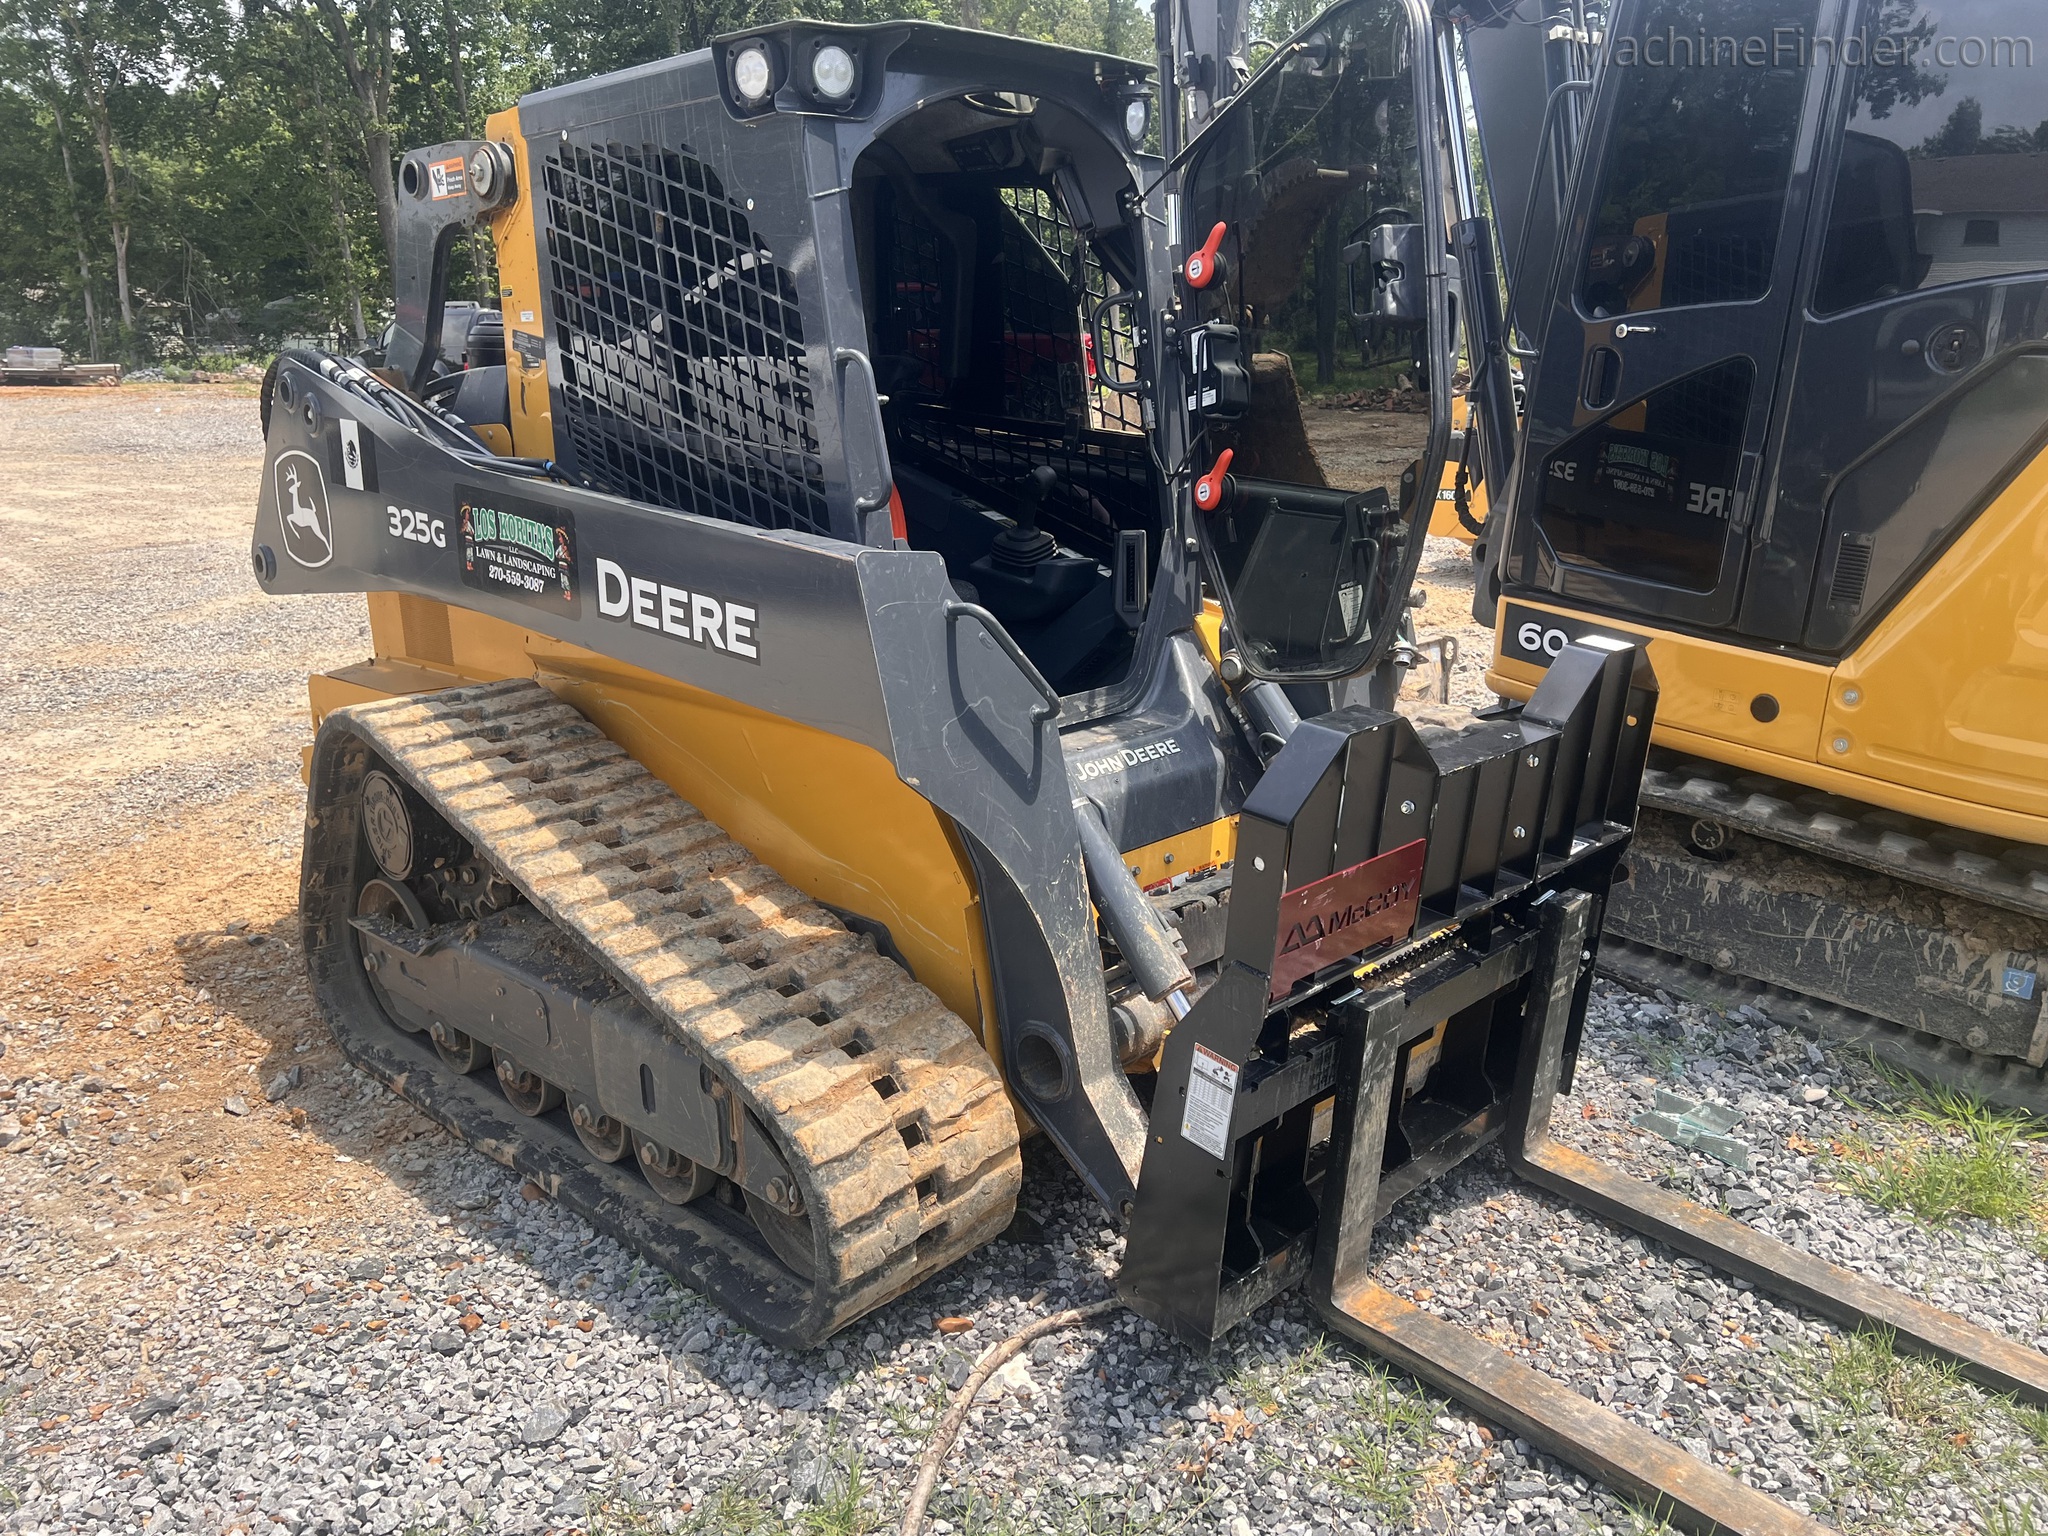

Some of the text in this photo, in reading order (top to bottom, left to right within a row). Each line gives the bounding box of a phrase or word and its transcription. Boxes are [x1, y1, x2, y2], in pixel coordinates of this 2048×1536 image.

[386, 505, 447, 549] 325G
[472, 507, 497, 541] LOS
[476, 546, 556, 579] LAWN & LANDSCAPING
[488, 565, 545, 594] 270-559-3087
[595, 557, 759, 660] DEERE
[1076, 739, 1181, 781] JOHN DEERE
